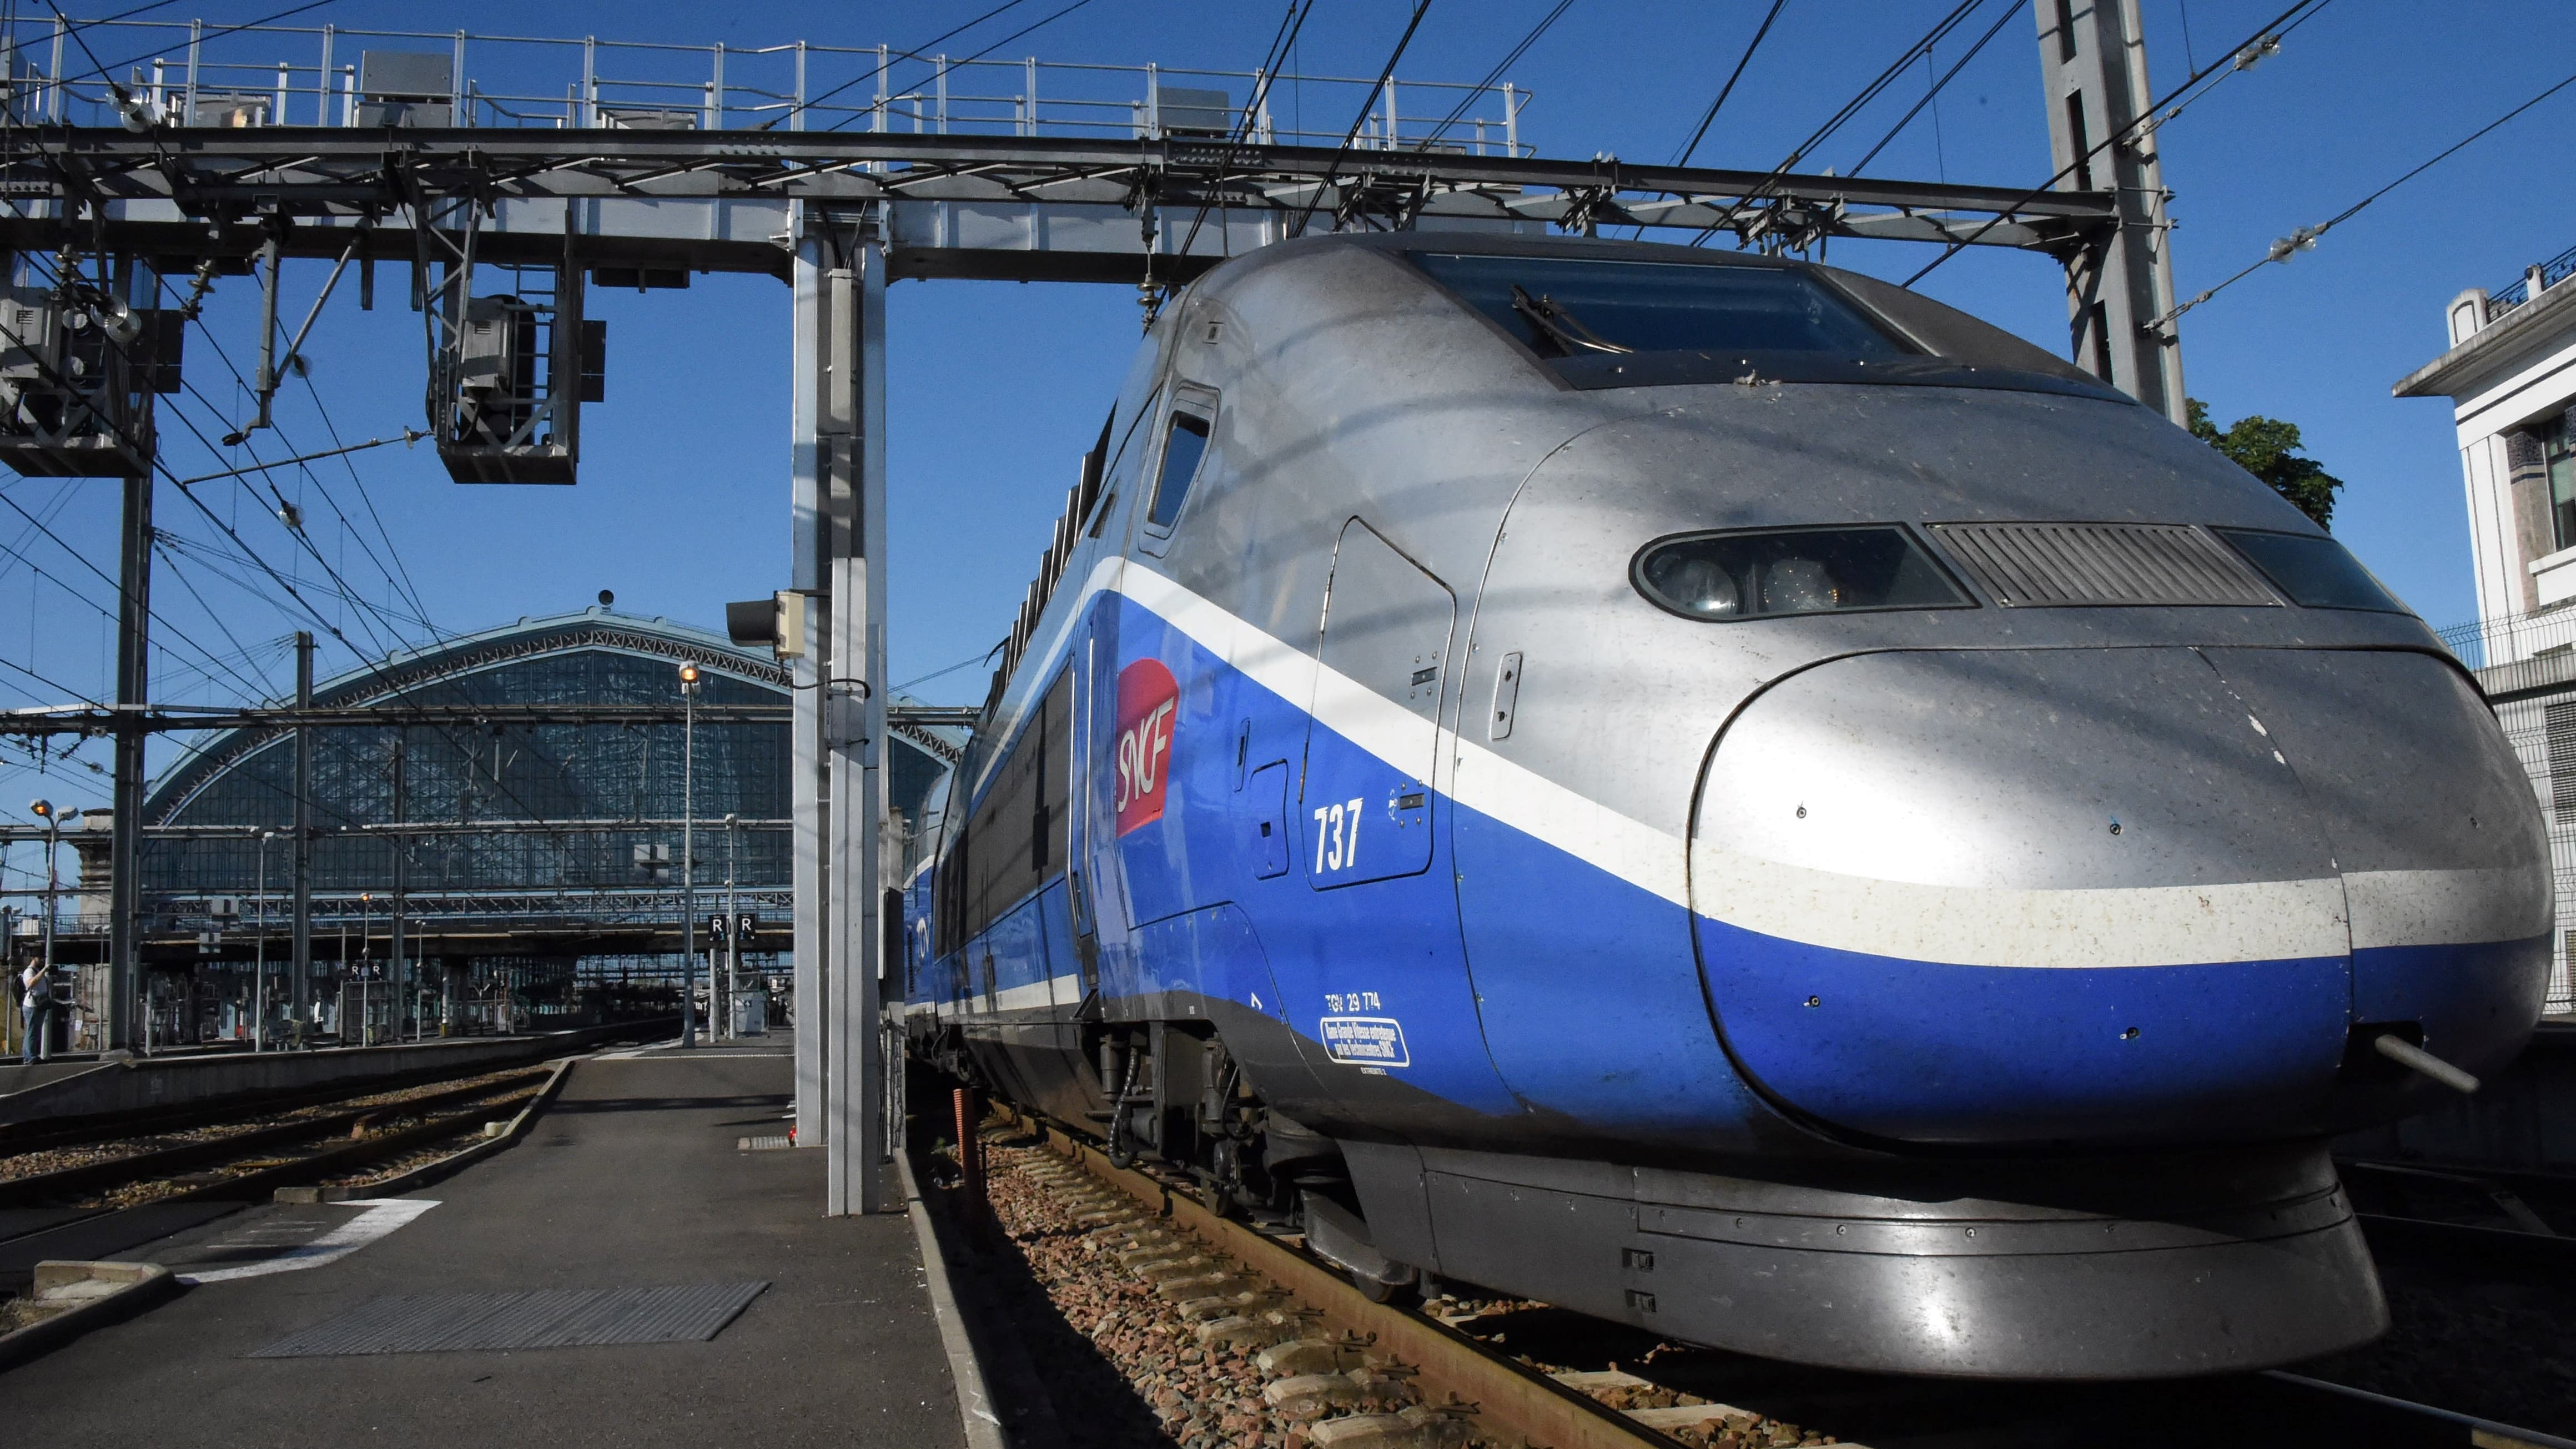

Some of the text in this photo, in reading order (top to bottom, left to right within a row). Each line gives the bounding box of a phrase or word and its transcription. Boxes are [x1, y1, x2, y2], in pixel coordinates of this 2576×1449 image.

[1118, 696, 1174, 813] SNCF
[1314, 797, 1364, 874] 737
[713, 919, 722, 932] R
[742, 918, 751, 931] R
[351, 965, 359, 975] R
[373, 965, 380, 975] R
[1325, 992, 1381, 1012] TGV 29 774
